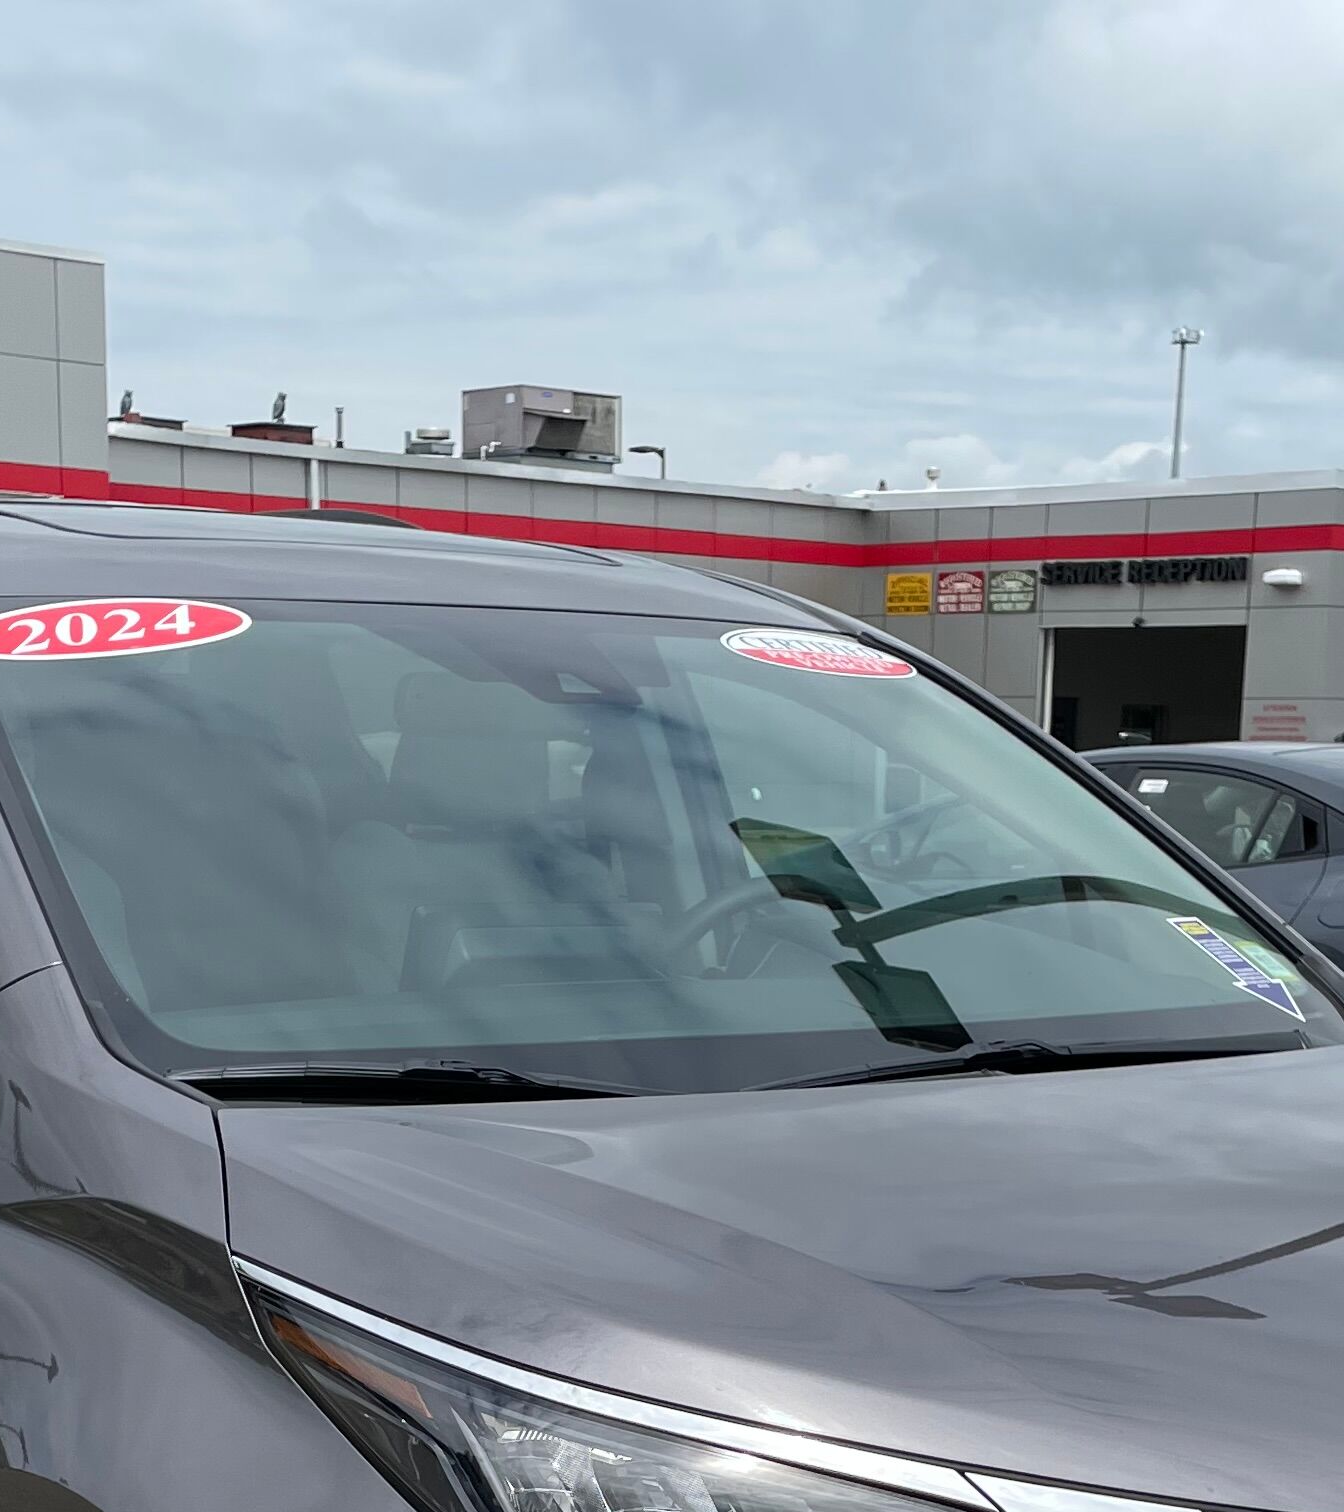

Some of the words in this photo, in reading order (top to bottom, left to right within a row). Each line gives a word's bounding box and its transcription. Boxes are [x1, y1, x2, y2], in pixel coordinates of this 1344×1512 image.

[1041, 561, 1123, 585] SERVICE
[1127, 556, 1248, 584] RECEPTION
[7, 604, 196, 655] 2024
